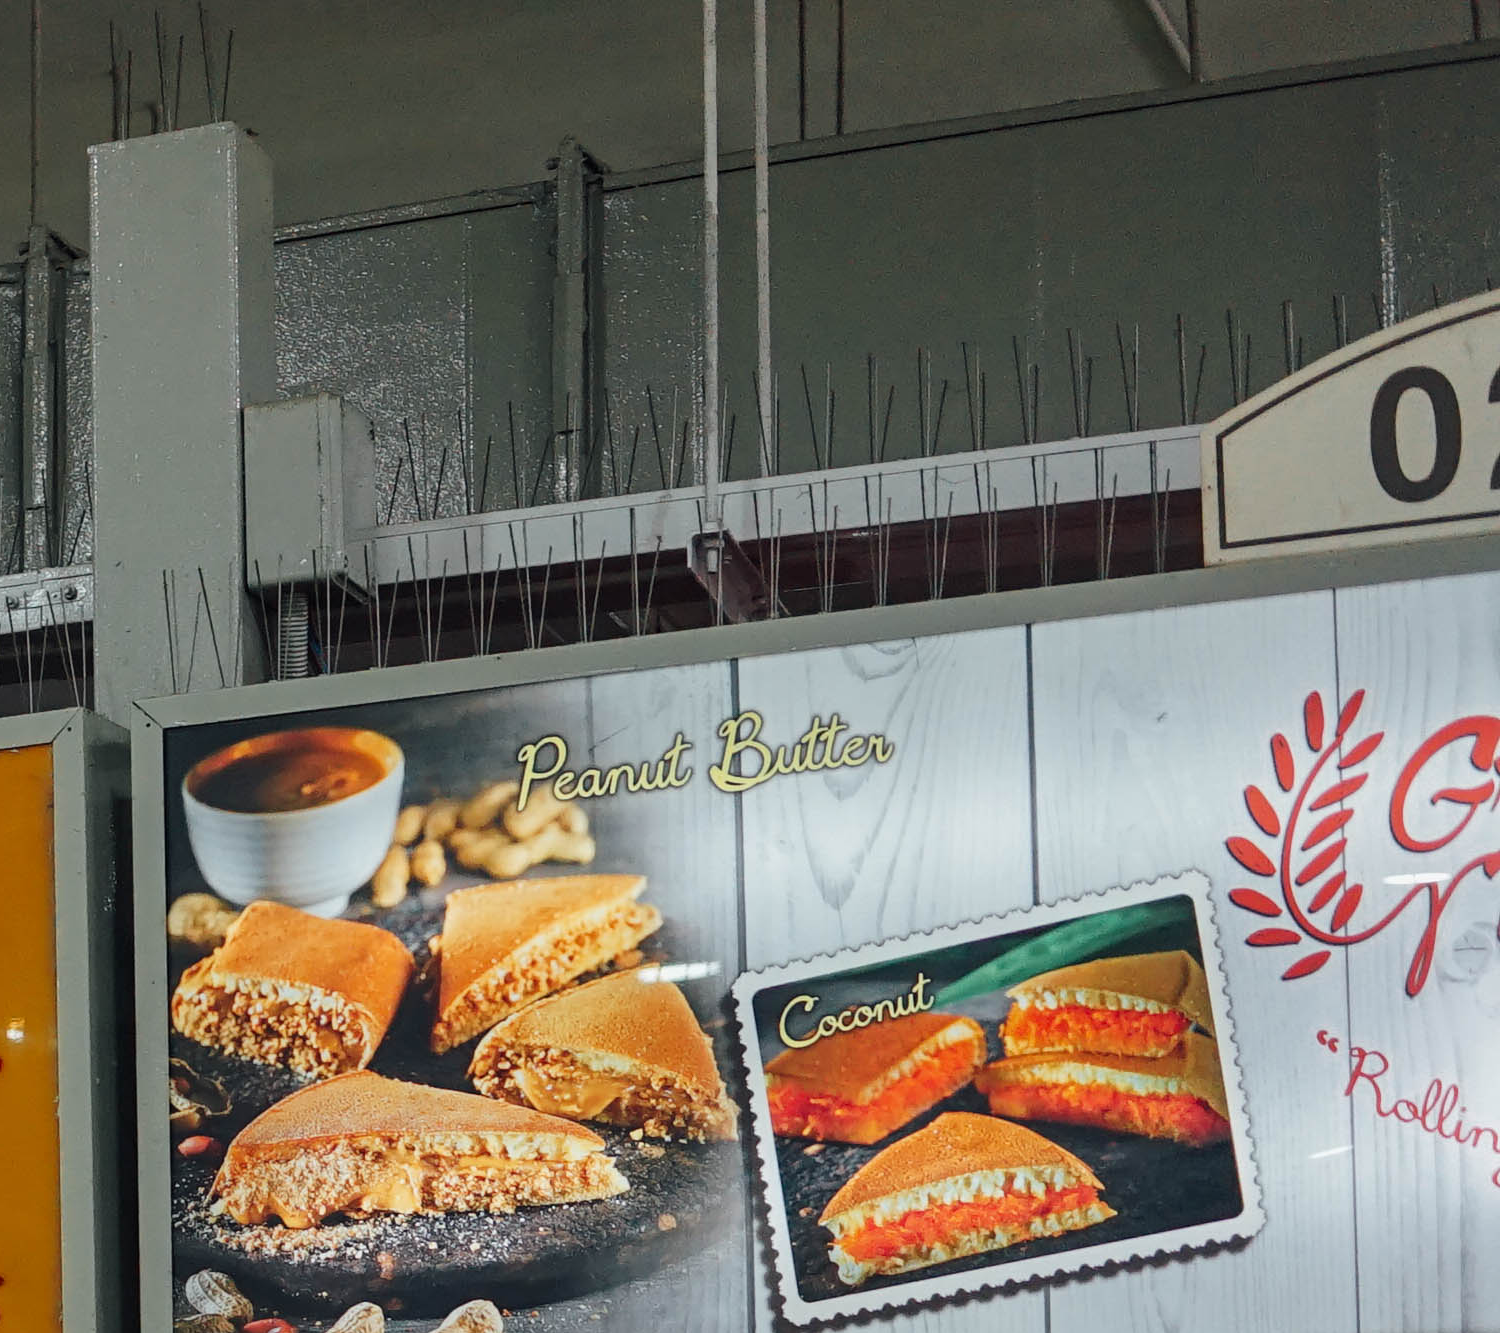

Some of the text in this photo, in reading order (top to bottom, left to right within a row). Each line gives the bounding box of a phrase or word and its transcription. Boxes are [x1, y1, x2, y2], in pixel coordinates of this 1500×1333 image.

[1369, 365, 1500, 504] 0
[515, 708, 896, 813] Peanut Butter
[777, 973, 936, 1051] Coconut
